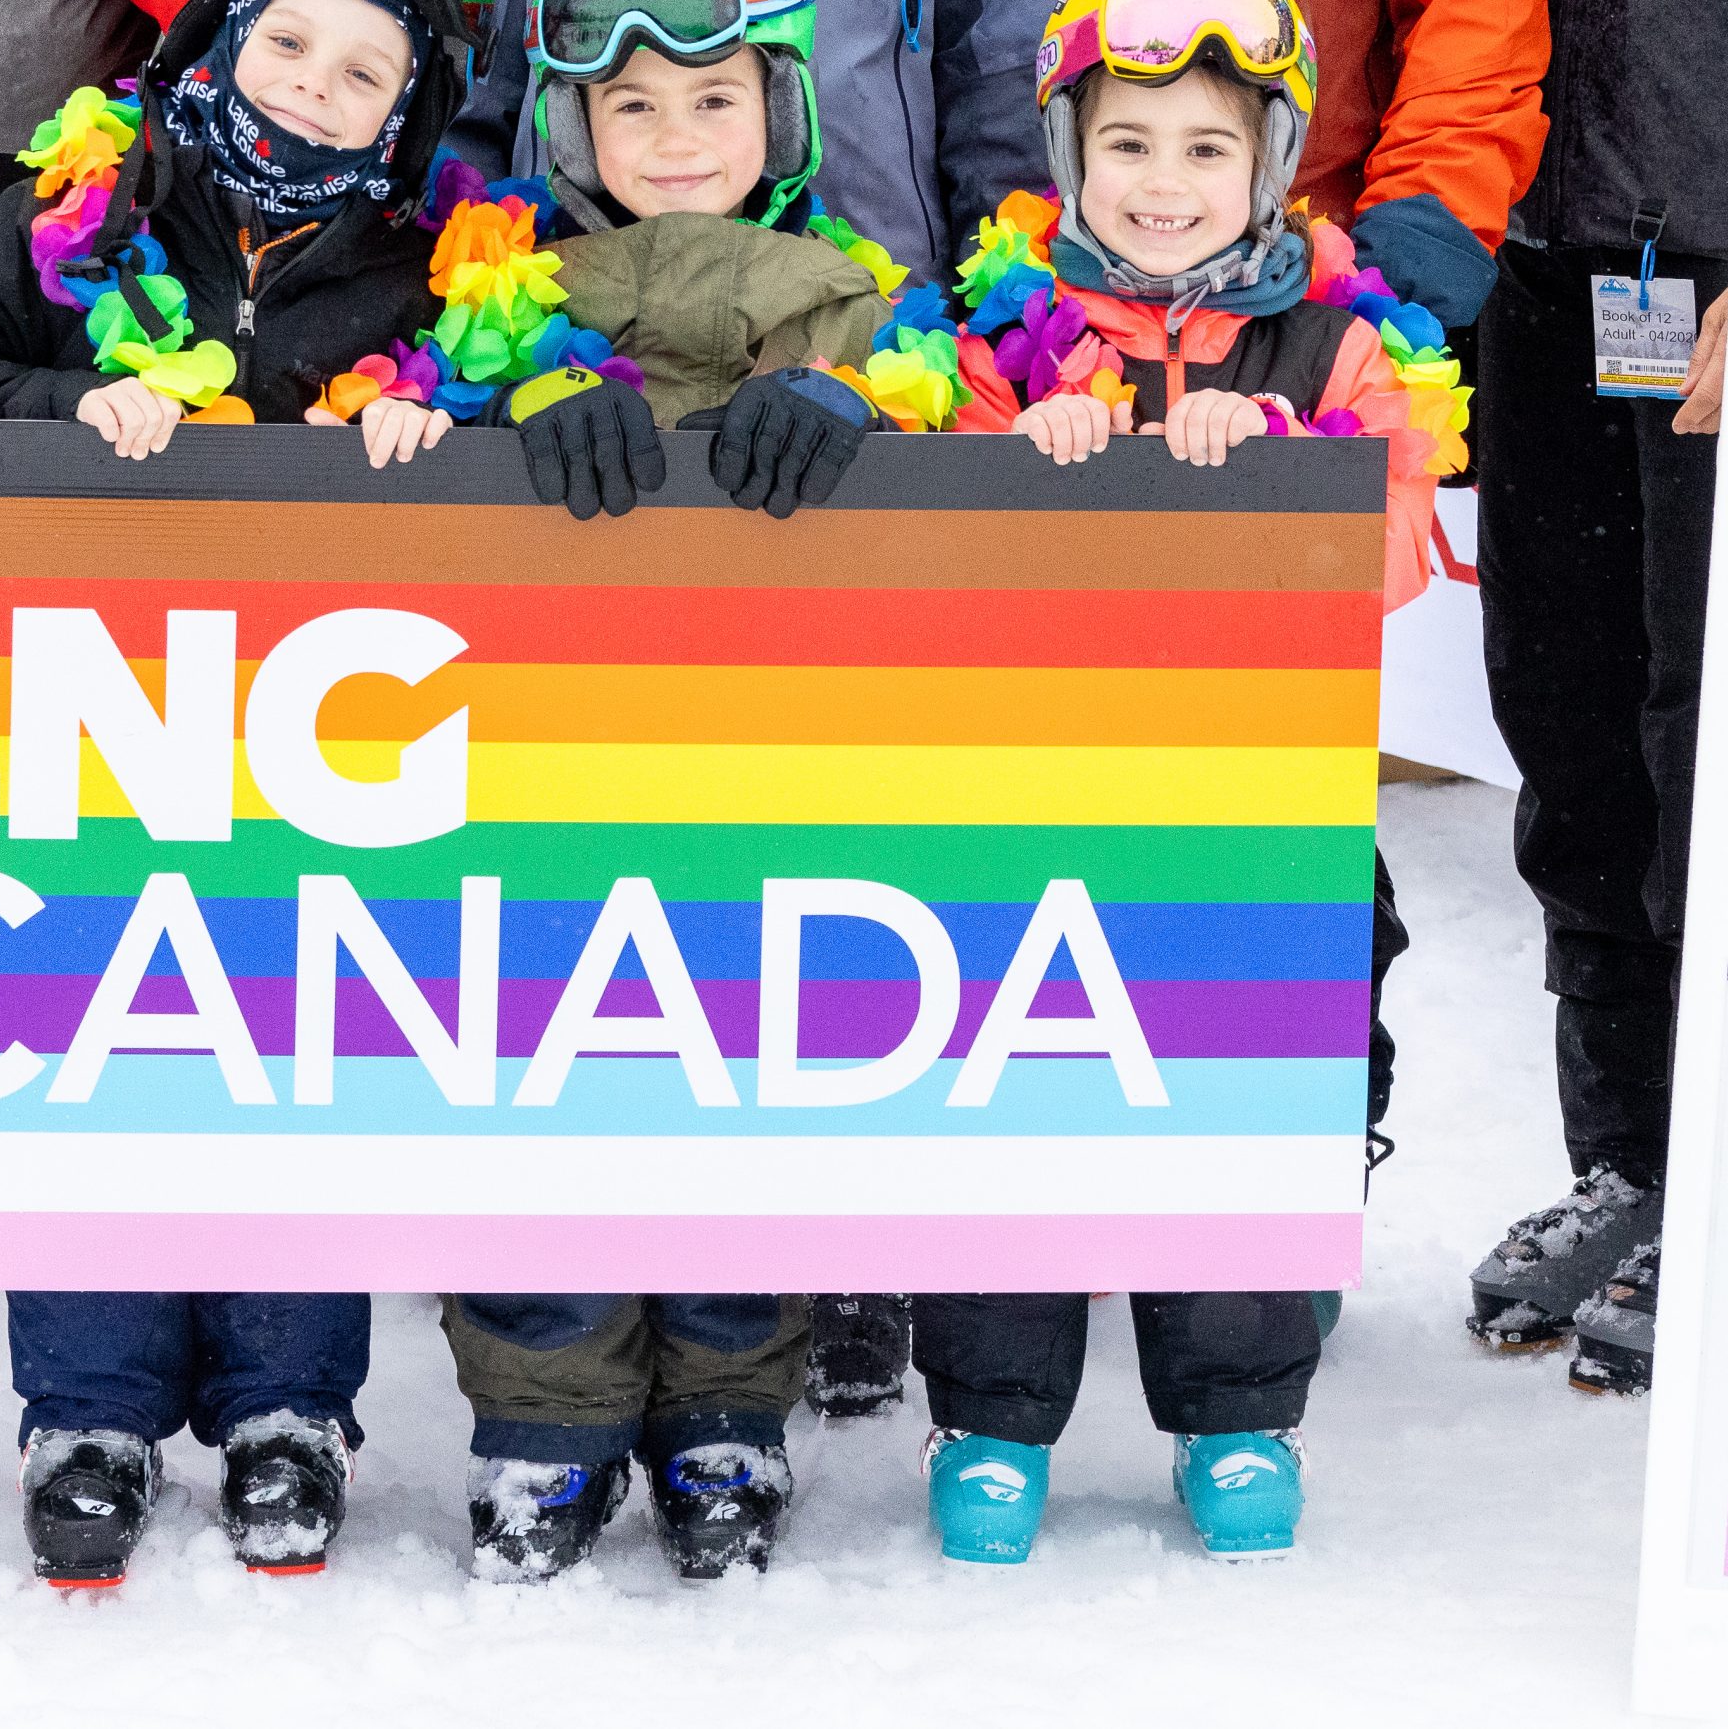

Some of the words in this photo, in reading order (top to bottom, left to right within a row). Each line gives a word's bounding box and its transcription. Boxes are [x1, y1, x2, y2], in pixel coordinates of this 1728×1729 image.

[227, 95, 260, 144] Lake
[232, 124, 287, 178] Louise
[1602, 309, 1636, 323] Book
[1639, 311, 1653, 323] of
[1656, 312, 1672, 324] 12
[1602, 327, 1637, 341] Adult
